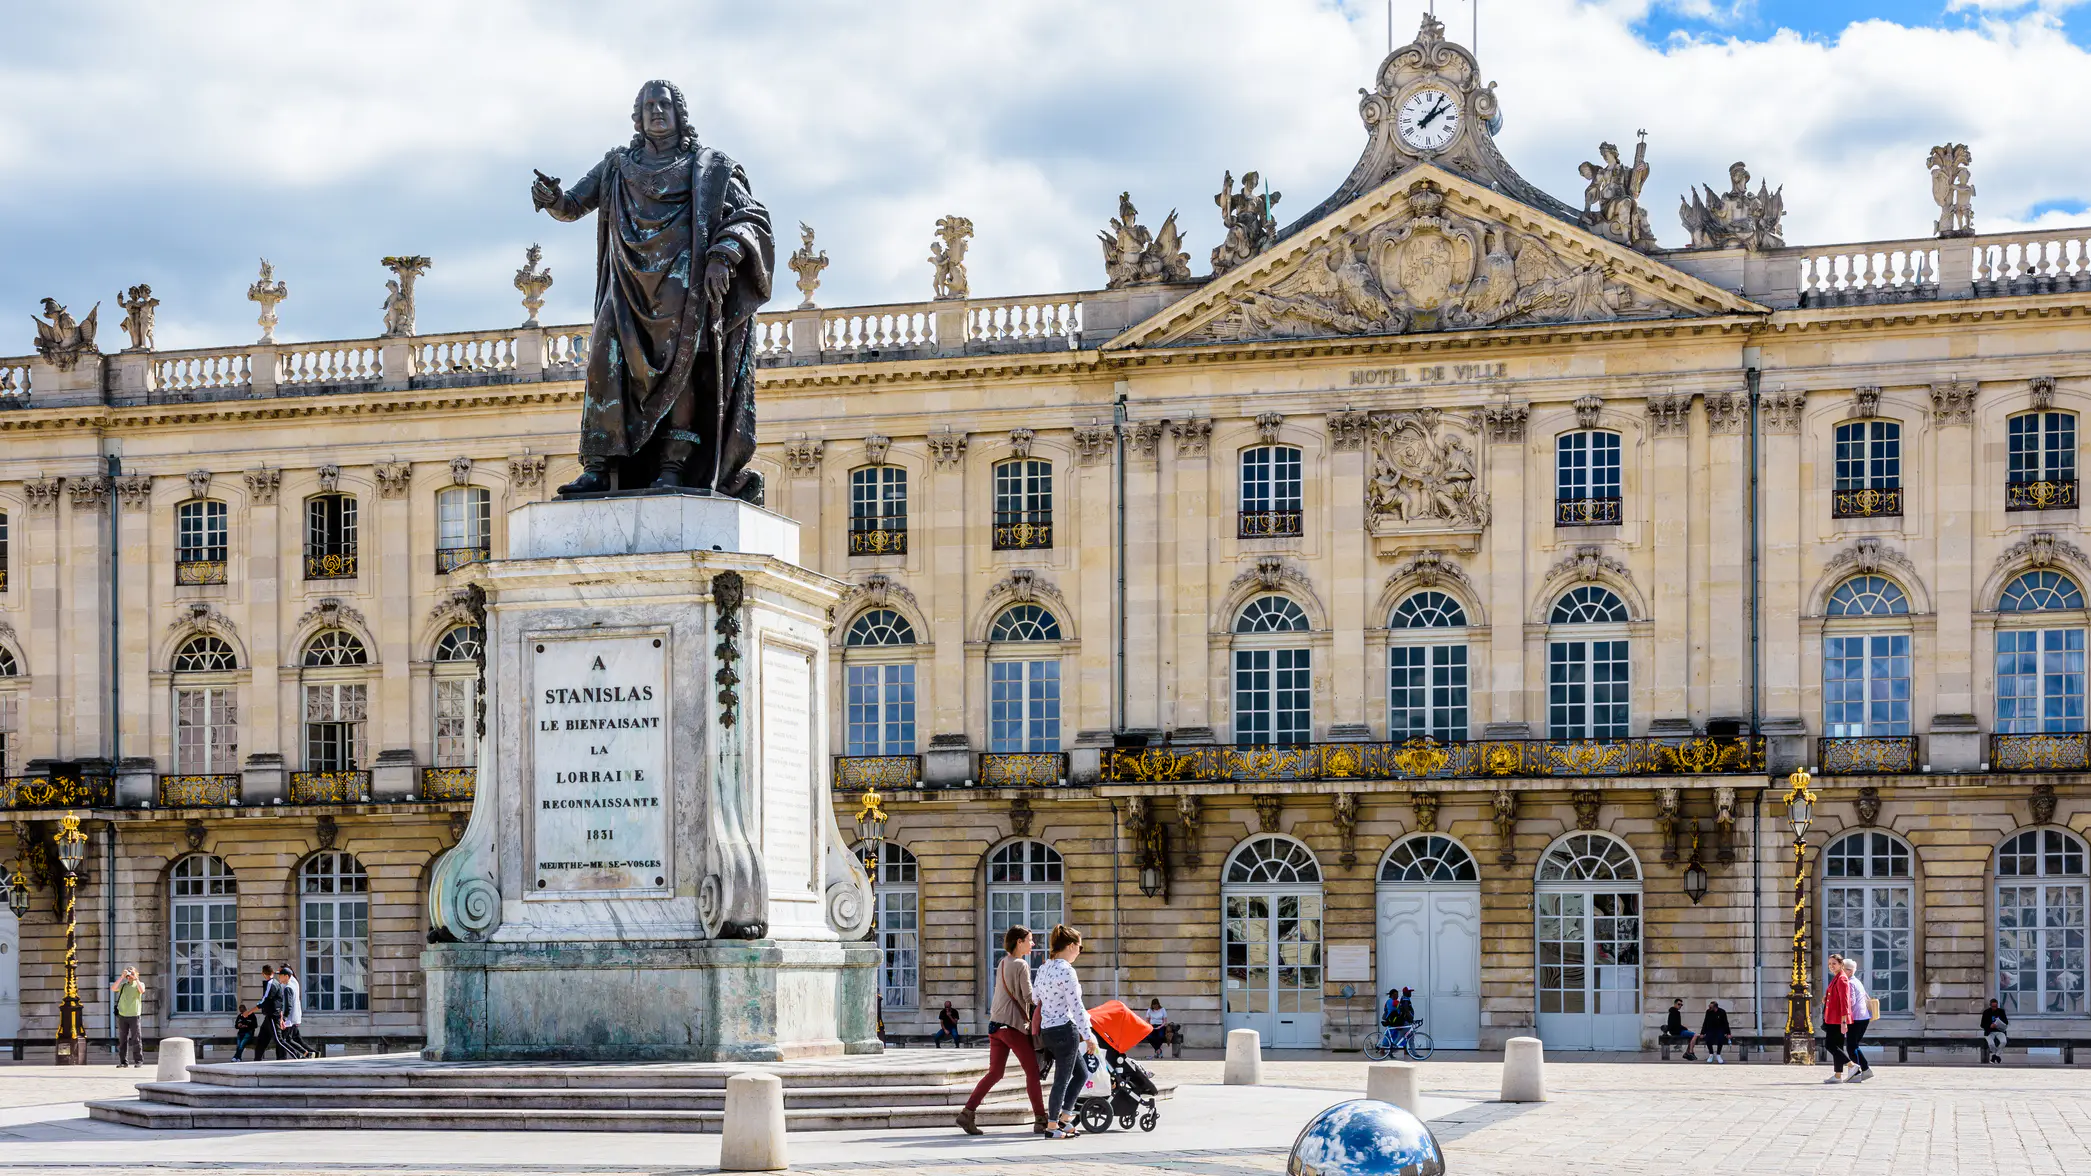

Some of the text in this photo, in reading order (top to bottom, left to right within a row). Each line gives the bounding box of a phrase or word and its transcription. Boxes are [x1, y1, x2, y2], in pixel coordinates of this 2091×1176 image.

[1350, 362, 1508, 385] HOTEL DE VILLE
[592, 655, 606, 670] A
[545, 686, 653, 704] STANISLAS
[541, 717, 659, 731] LE BIENFAISANT
[590, 745, 609, 755] LA
[556, 769, 644, 784] LORRAINE
[542, 797, 658, 809] RECONNAISSANTE
[587, 829, 614, 840] 1831
